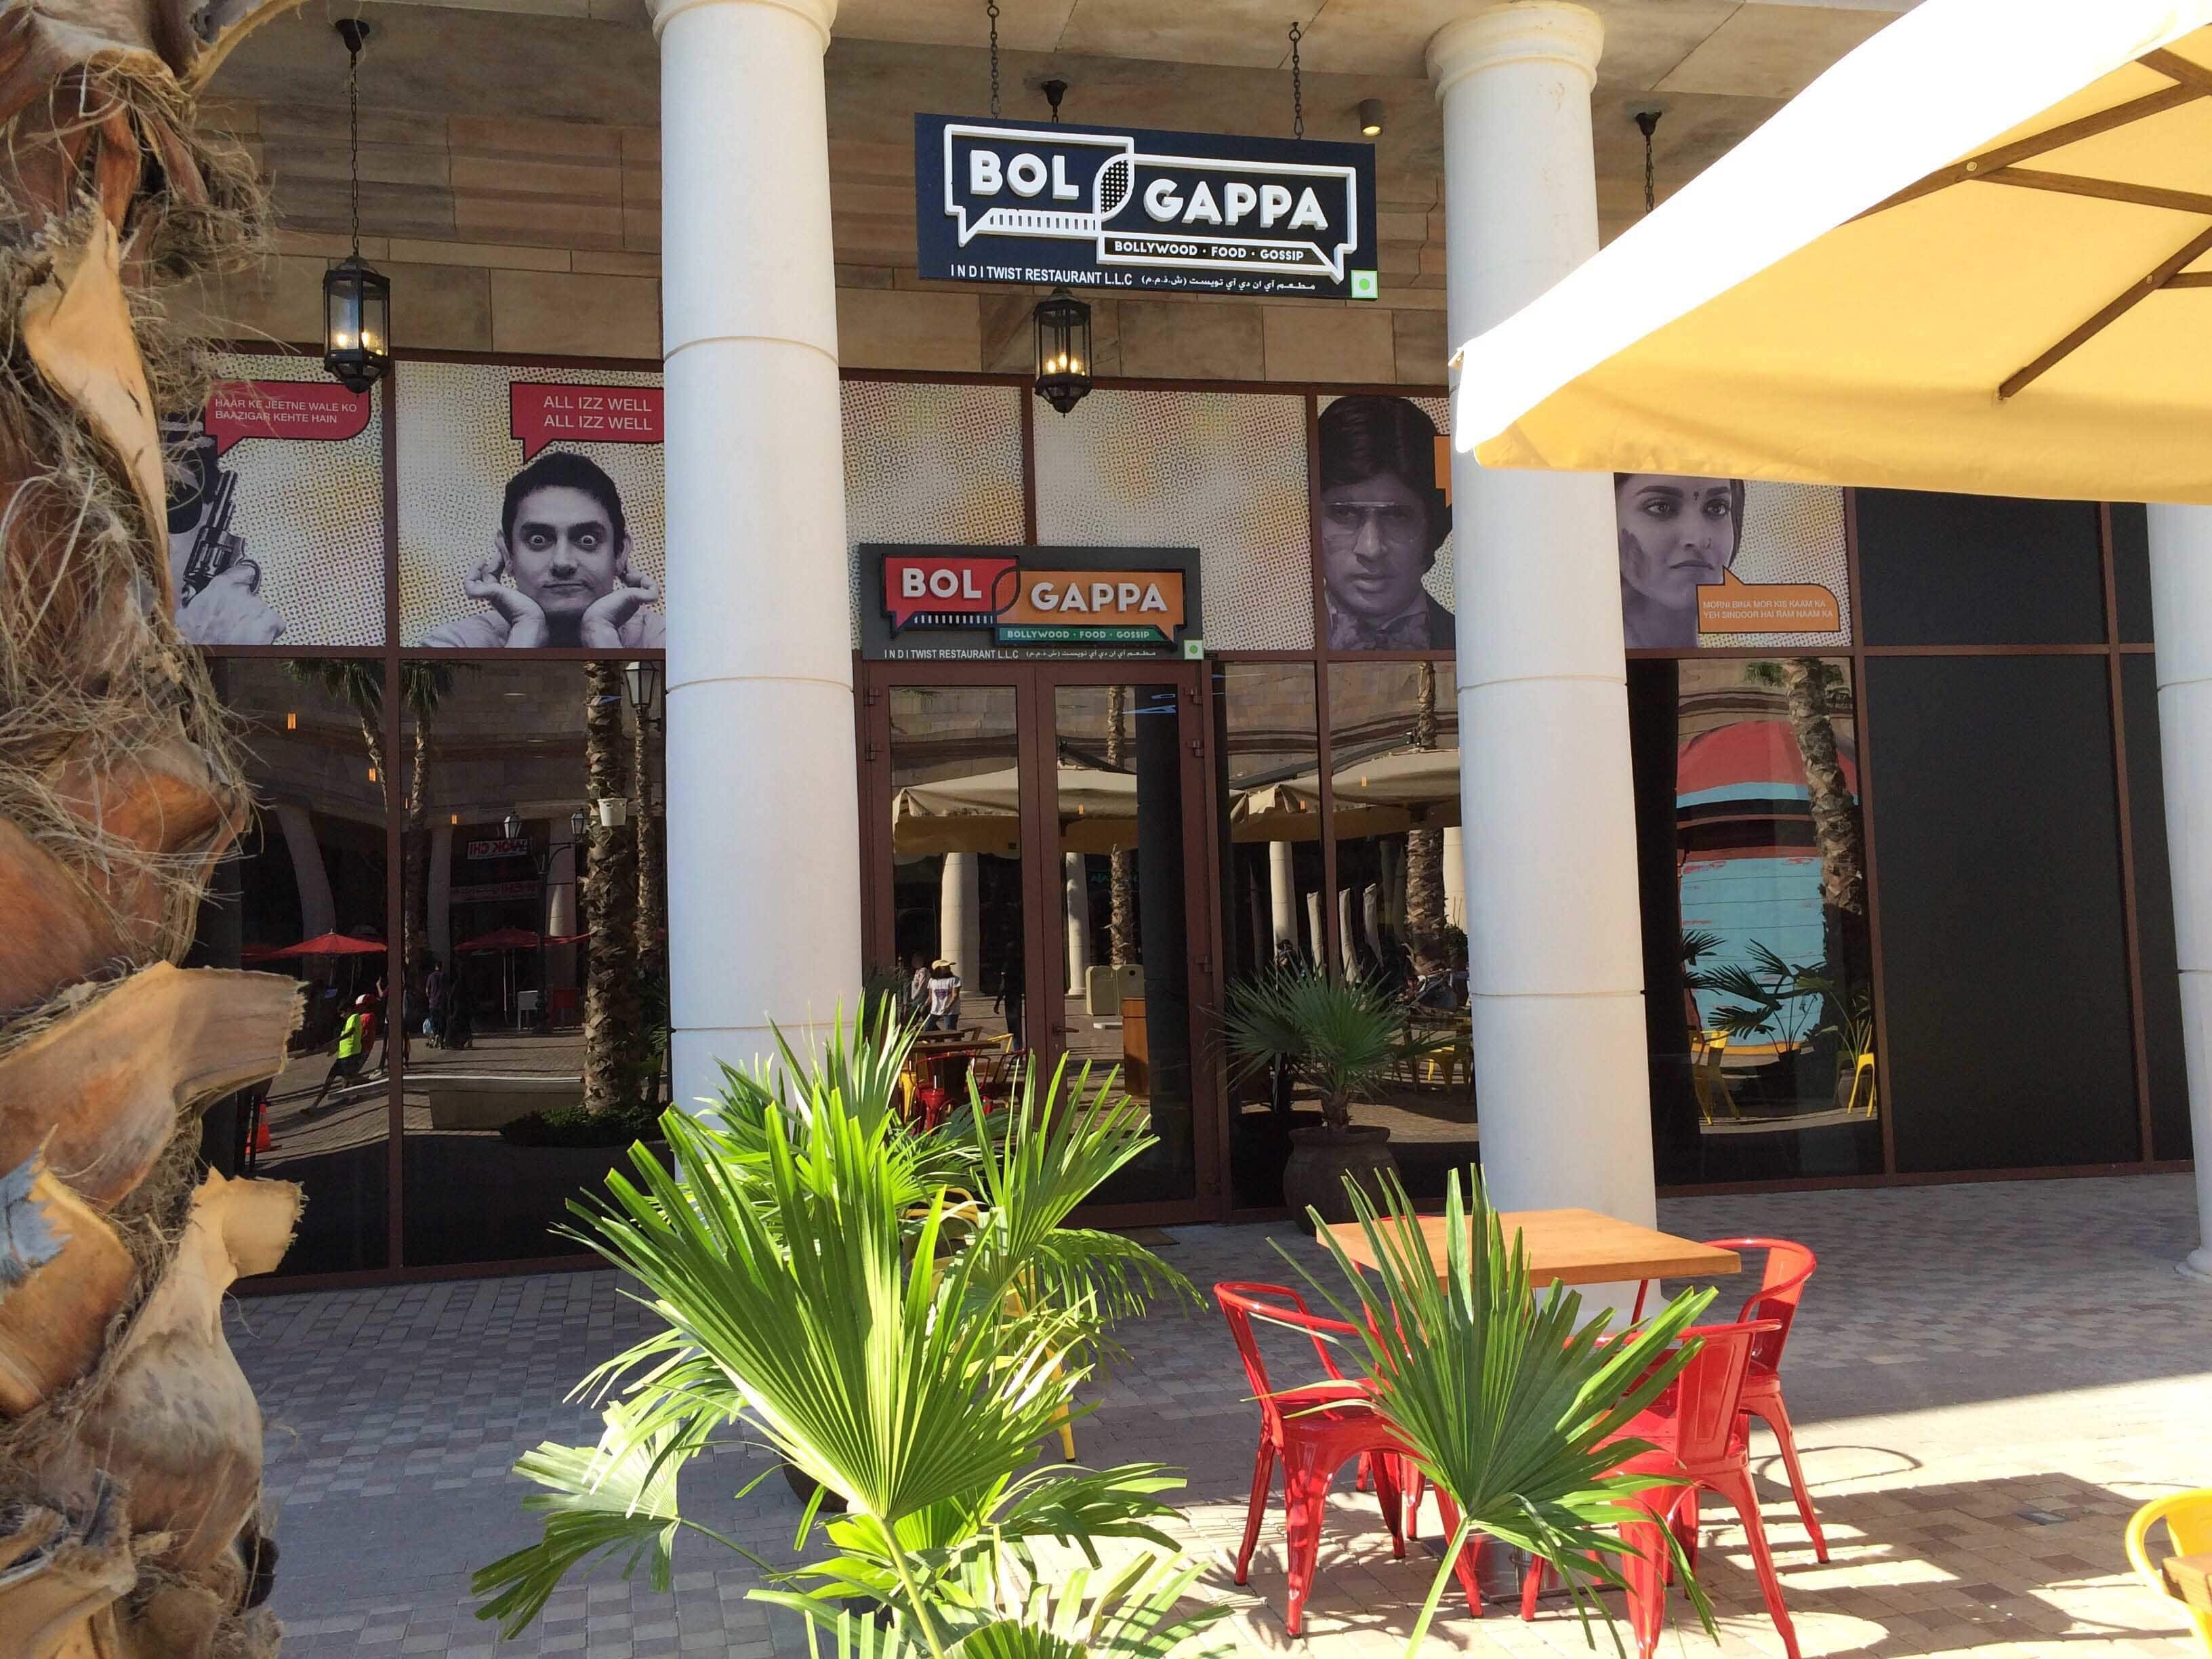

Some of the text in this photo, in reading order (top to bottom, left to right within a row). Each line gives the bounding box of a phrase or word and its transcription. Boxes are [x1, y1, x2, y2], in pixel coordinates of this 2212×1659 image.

[969, 149, 1080, 200] BOL
[1143, 178, 1329, 231] GAPPA
[1114, 241, 1305, 262] BOLLYWOOD FOOD GOSSIP
[986, 266, 1023, 280] TWIST
[1025, 268, 1103, 285] RESTAURANT
[1104, 272, 1133, 286] L.L.C
[1189, 276, 1225, 288] تويست
[1276, 281, 1316, 291] مطعم
[215, 398, 357, 413] HAAR KE JEETNE WALE KO
[543, 395, 653, 412] ALL IZZ WELL
[215, 410, 337, 424] BAAZIGAR KEHTE HAIN
[544, 414, 653, 430] ALL IZZ WELL
[902, 567, 983, 600] BOL
[1030, 581, 1168, 613] GAPPA
[1703, 600, 1730, 609] MORNI
[1732, 600, 1752, 609] BINA
[1774, 600, 1788, 608] KIS
[1789, 600, 1813, 608] KAAM
[1814, 600, 1826, 608] KA
[1007, 630, 1150, 639] BOLLYWOOD FOOD GOSSIP
[911, 649, 937, 659] TWIST
[939, 649, 996, 659] RESTAURANT
[998, 650, 1019, 659] L.L.C
